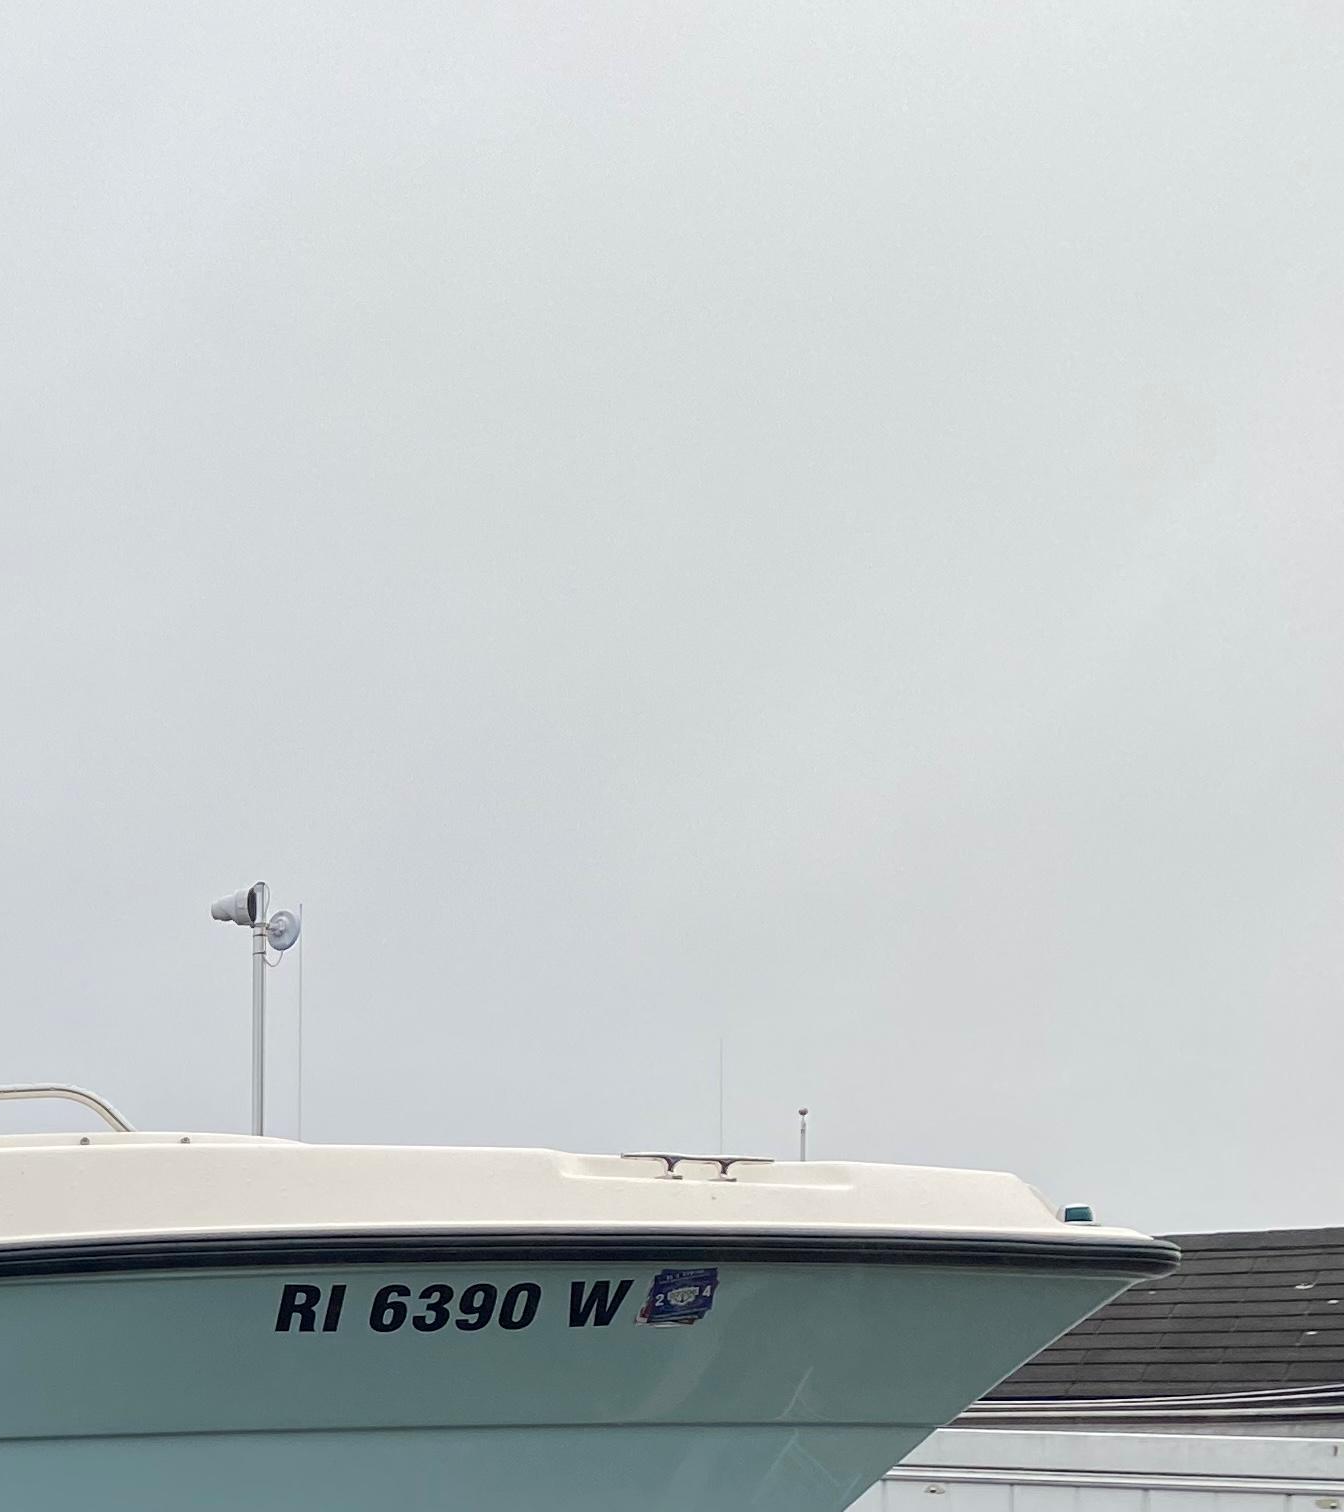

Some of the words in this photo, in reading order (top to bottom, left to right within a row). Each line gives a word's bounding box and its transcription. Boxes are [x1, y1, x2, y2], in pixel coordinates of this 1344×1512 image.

[275, 1284, 347, 1332] RI
[369, 1283, 542, 1332] 6390
[568, 1279, 635, 1328] W
